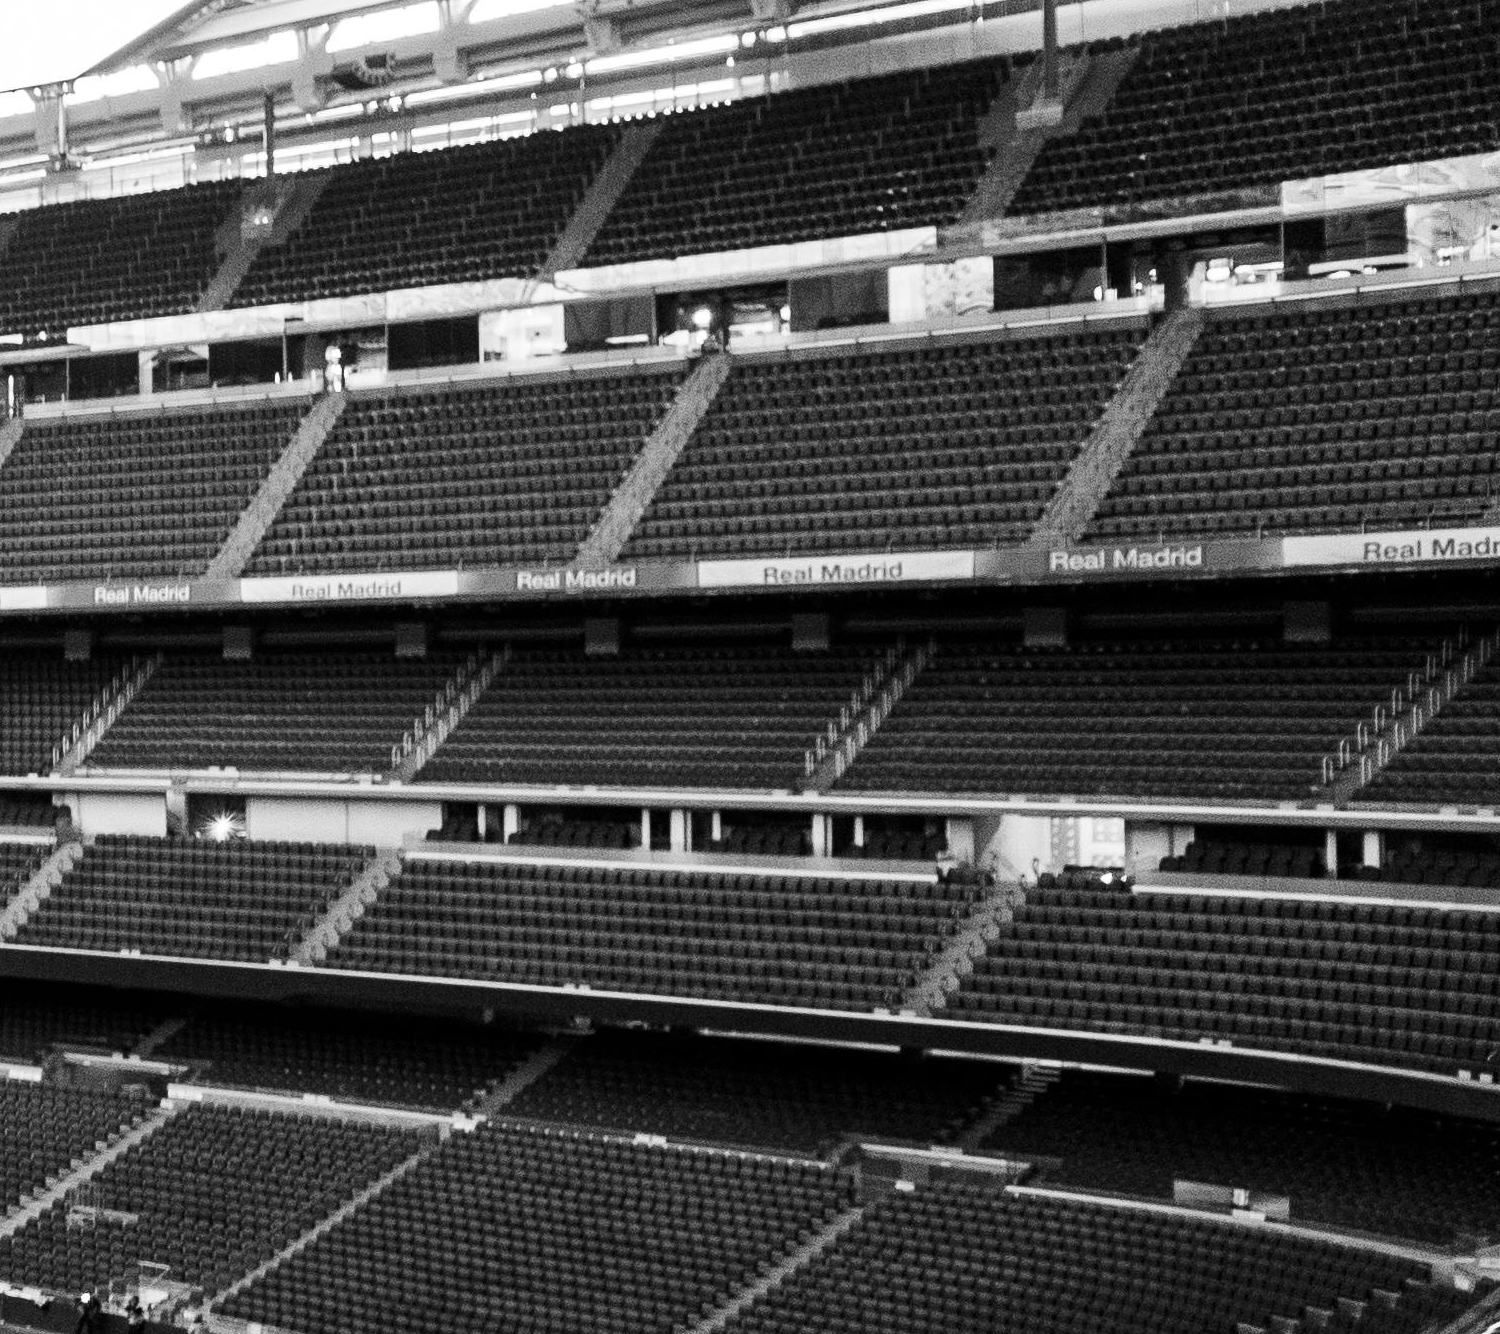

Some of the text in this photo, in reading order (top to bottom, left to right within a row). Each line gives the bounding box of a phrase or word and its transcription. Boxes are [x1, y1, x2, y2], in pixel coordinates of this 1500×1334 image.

[1050, 546, 1201, 571] Real Madrid
[1363, 540, 1422, 561] Real
[517, 568, 636, 590] Real Madrid
[763, 562, 903, 585] Real Madrid
[94, 584, 190, 604] Real Madrid
[292, 581, 401, 600] Real Madrid
